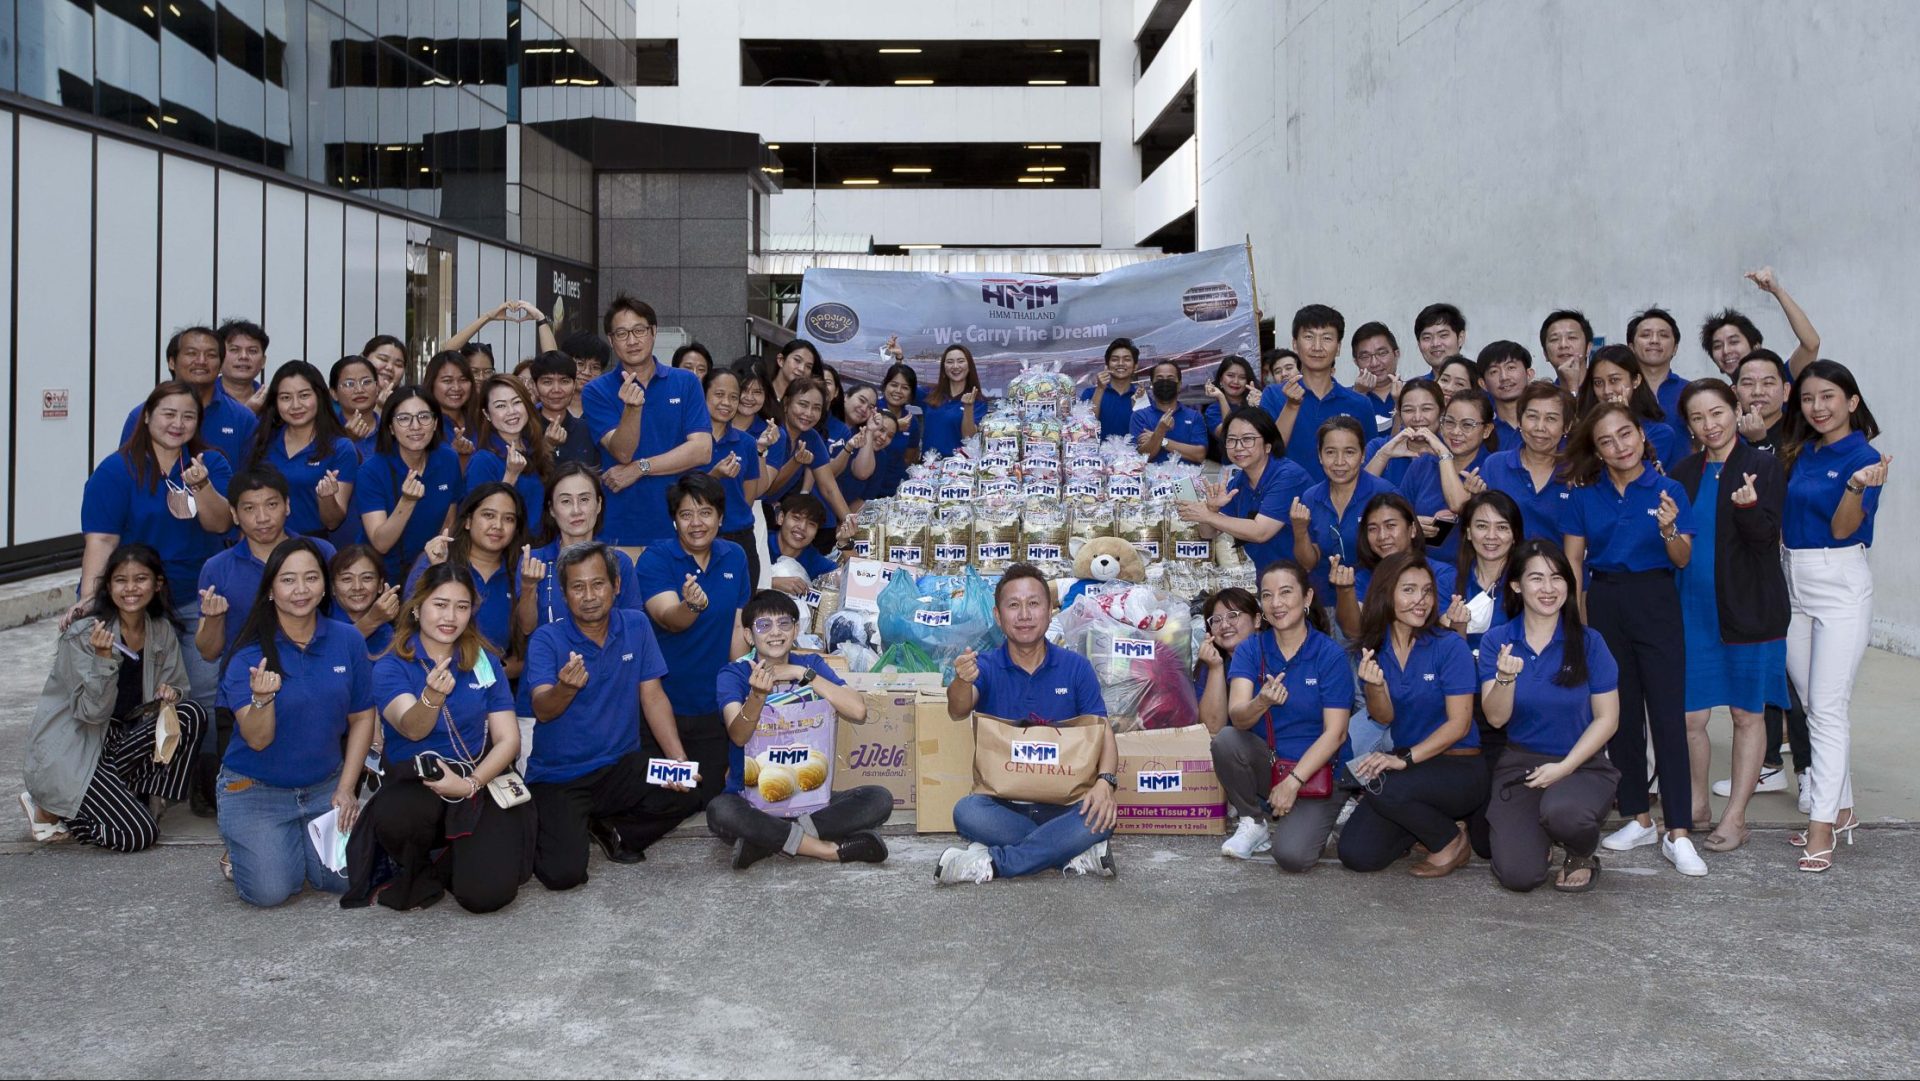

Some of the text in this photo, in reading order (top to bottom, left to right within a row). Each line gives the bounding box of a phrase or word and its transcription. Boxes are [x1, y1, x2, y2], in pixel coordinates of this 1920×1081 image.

[982, 283, 1058, 310] HMM
[989, 310, 1056, 320] HMM THAILAND
[934, 327, 962, 344] We
[966, 324, 1011, 346] Carry
[1015, 325, 1048, 342] The
[1052, 324, 1108, 339] Dream
[981, 457, 1008, 467] HMM
[1028, 459, 1056, 467] HMM
[1073, 459, 1100, 467] HMM
[902, 486, 932, 496] HMM
[941, 488, 969, 498] HMM
[1027, 486, 1054, 494] HMM
[1069, 486, 1096, 494] HMM
[1111, 486, 1139, 495] HMM
[891, 549, 919, 560] HMM
[936, 547, 965, 558] HMM
[980, 546, 1009, 557] HMM
[1029, 547, 1058, 558] HMM
[1177, 545, 1207, 556] HMM
[916, 612, 949, 624] HMM
[1114, 642, 1152, 656] HMM
[769, 750, 808, 764] HMM
[1014, 746, 1056, 761] HMM
[650, 765, 691, 782] HMM
[1004, 761, 1076, 776] CENTRAL
[1140, 776, 1179, 790] HMM
[1117, 807, 1212, 818] oll Toilet Tissue 2 Ply
